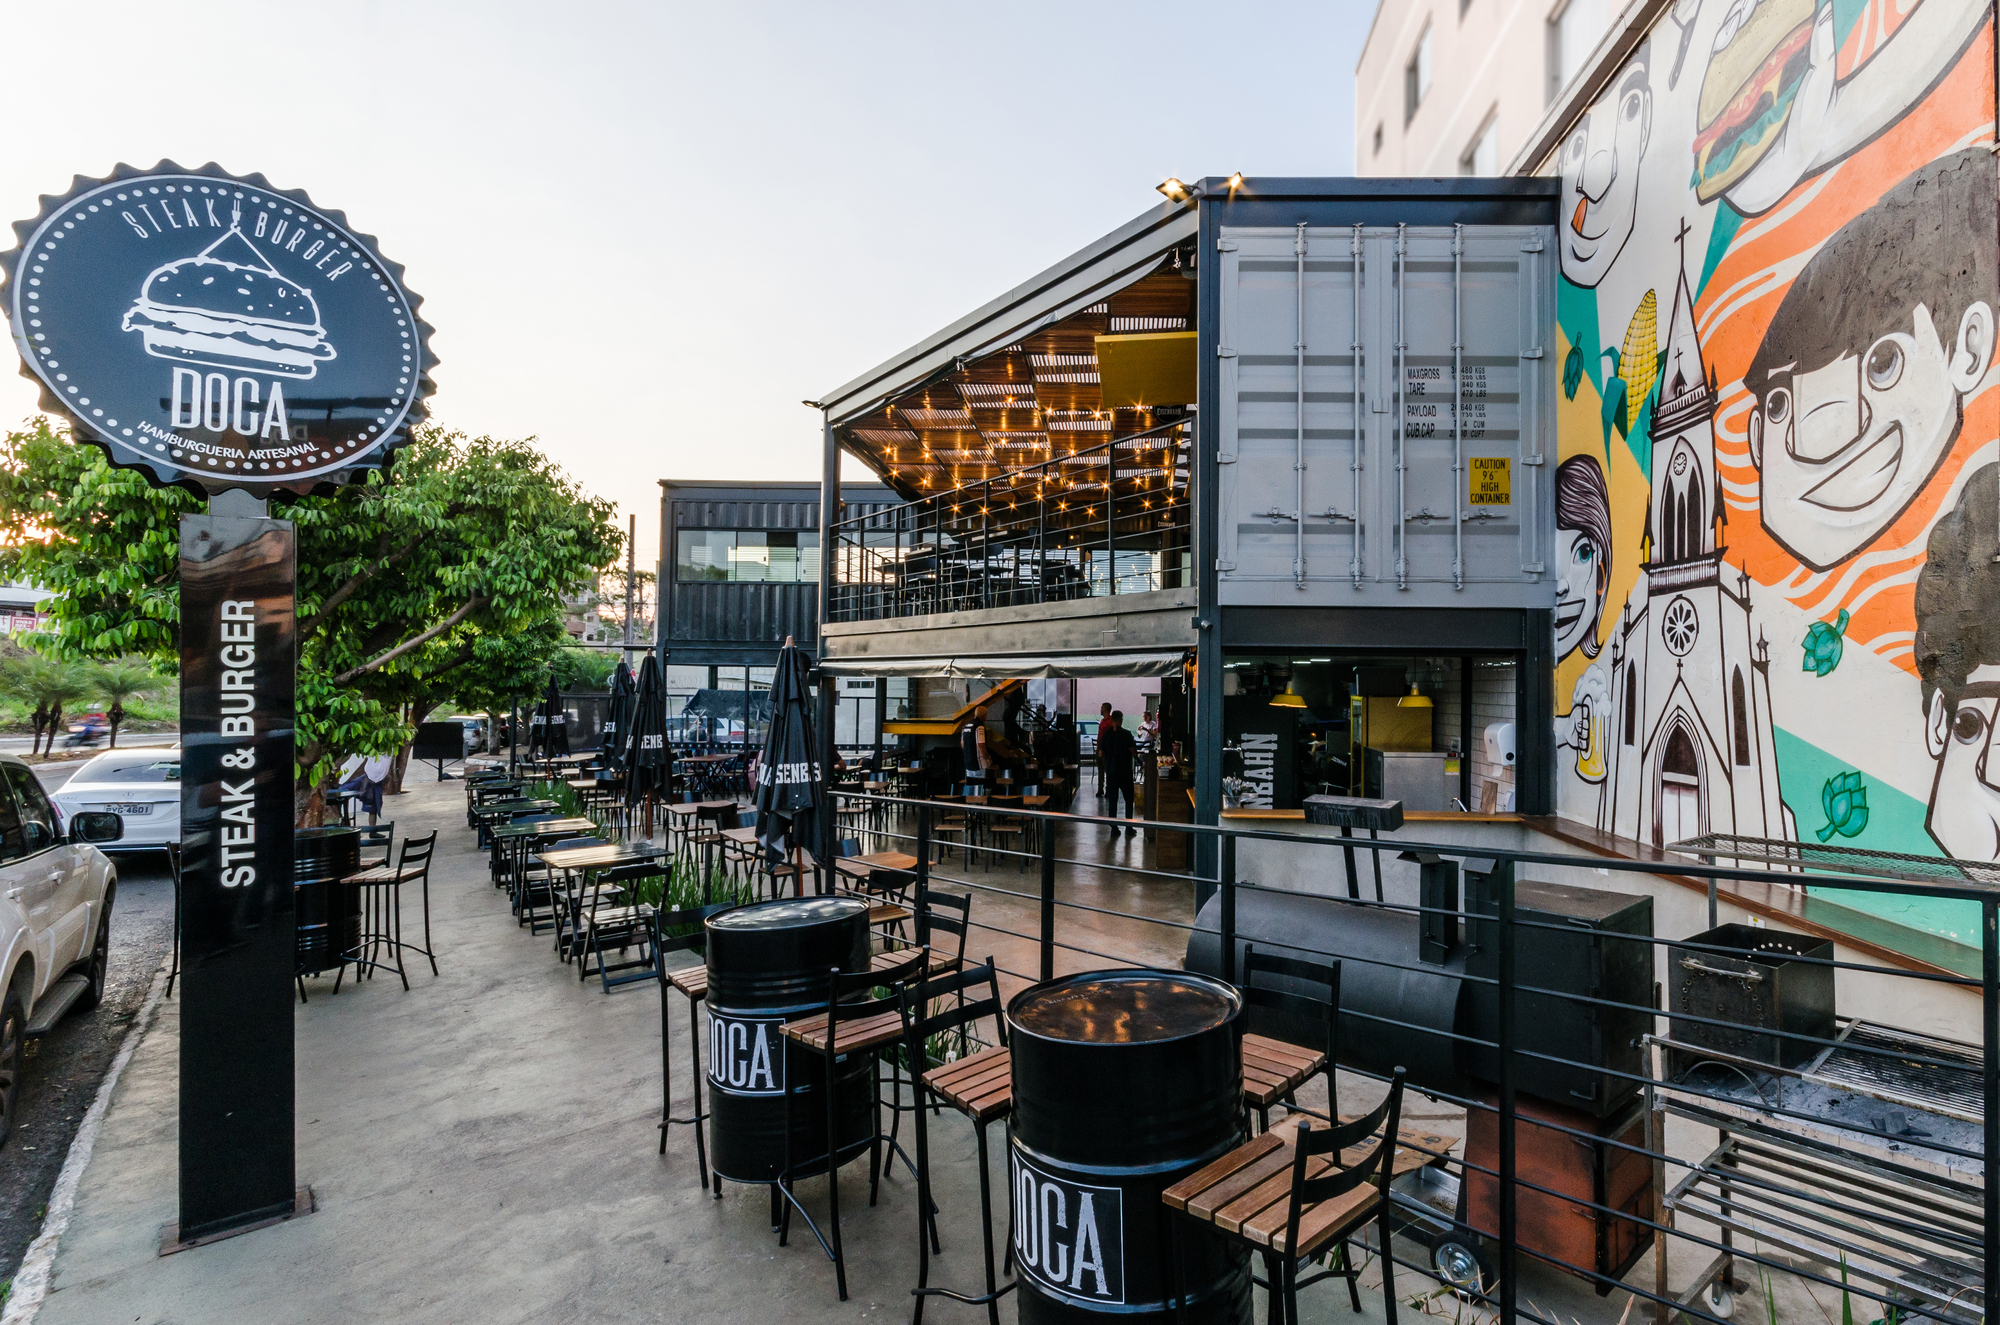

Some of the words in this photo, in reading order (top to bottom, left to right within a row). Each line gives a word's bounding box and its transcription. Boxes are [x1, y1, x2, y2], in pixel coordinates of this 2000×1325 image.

[122, 198, 221, 239] STEAK
[254, 211, 353, 281] BURGER
[1407, 368, 1440, 380] MAXGROSS
[1474, 366, 1486, 374] KGS
[1408, 382, 1426, 396] TARE
[171, 366, 291, 441] DOCA
[1407, 405, 1437, 418] PAYLOAD
[1474, 403, 1485, 411] KGS
[137, 420, 245, 459] HAMBURGUERIA
[247, 441, 320, 460] ARTESANAL
[1474, 459, 1506, 470] CAUTION
[1481, 482, 1499, 492] HIGH
[1470, 493, 1510, 504] CONTAINER
[221, 600, 255, 738] BURGER
[221, 746, 255, 770] &
[221, 778, 255, 888] STEAK
[708, 1011, 776, 1089] DOCA
[1012, 1150, 1112, 1296] DOCA
